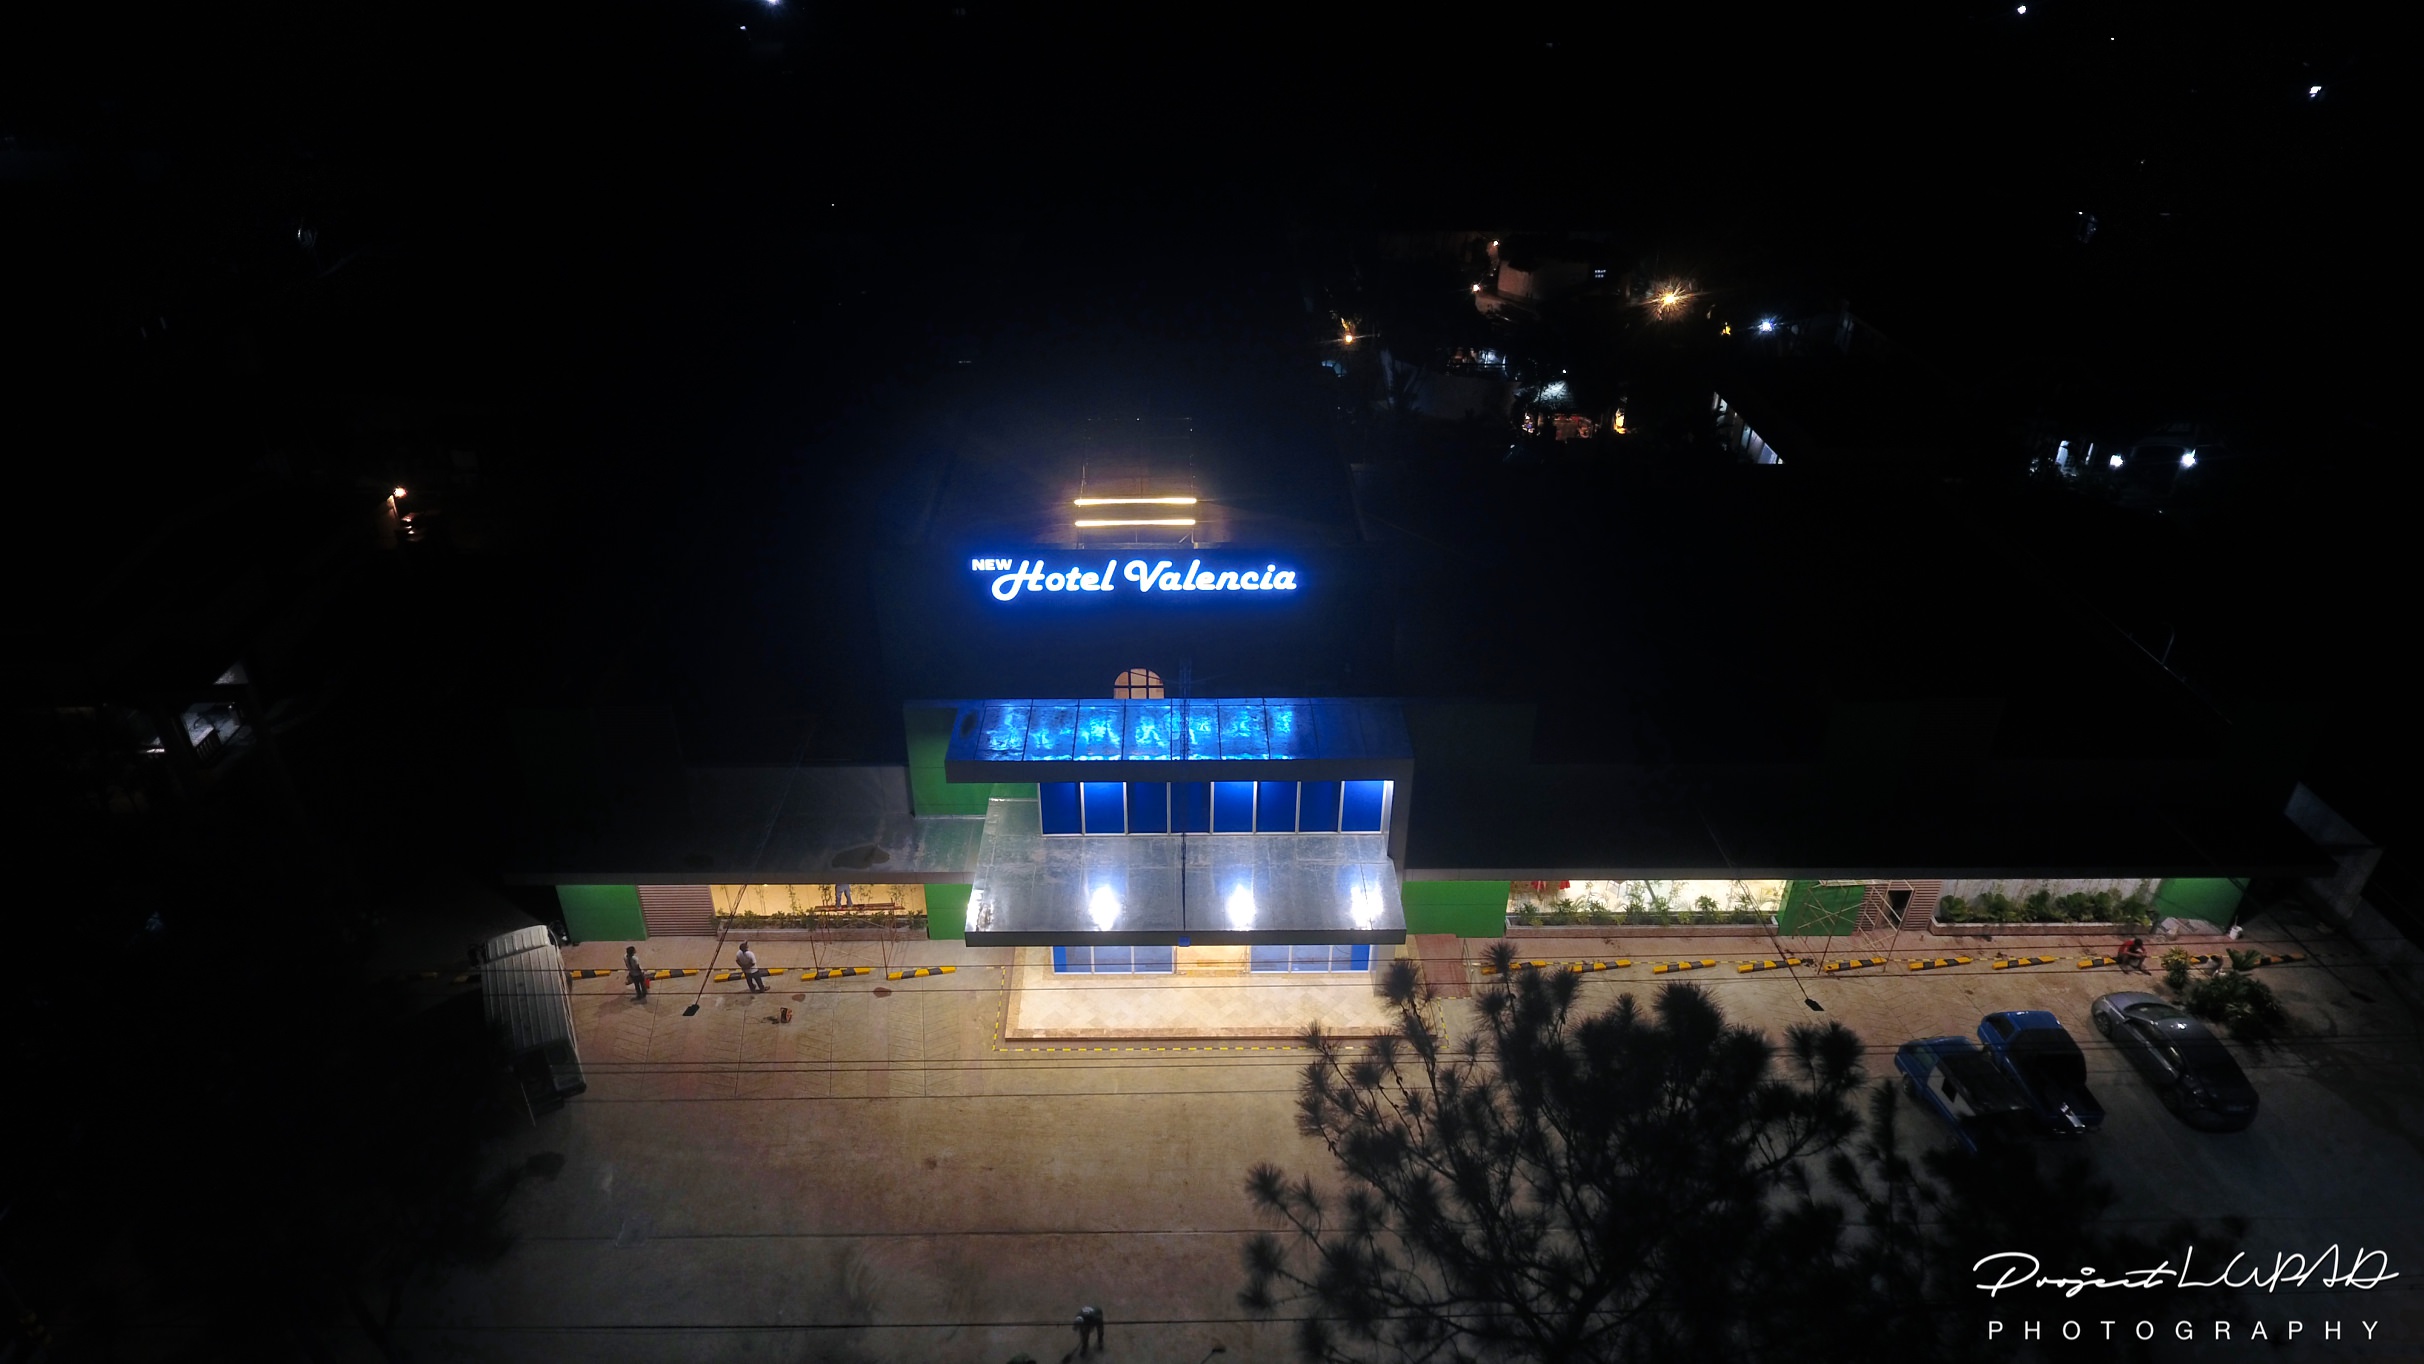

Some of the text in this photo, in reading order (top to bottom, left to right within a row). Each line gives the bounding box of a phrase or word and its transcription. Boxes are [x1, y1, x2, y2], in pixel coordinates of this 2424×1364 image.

[972, 558, 1012, 571] NEW
[991, 559, 1297, 601] Hotel Valencia
